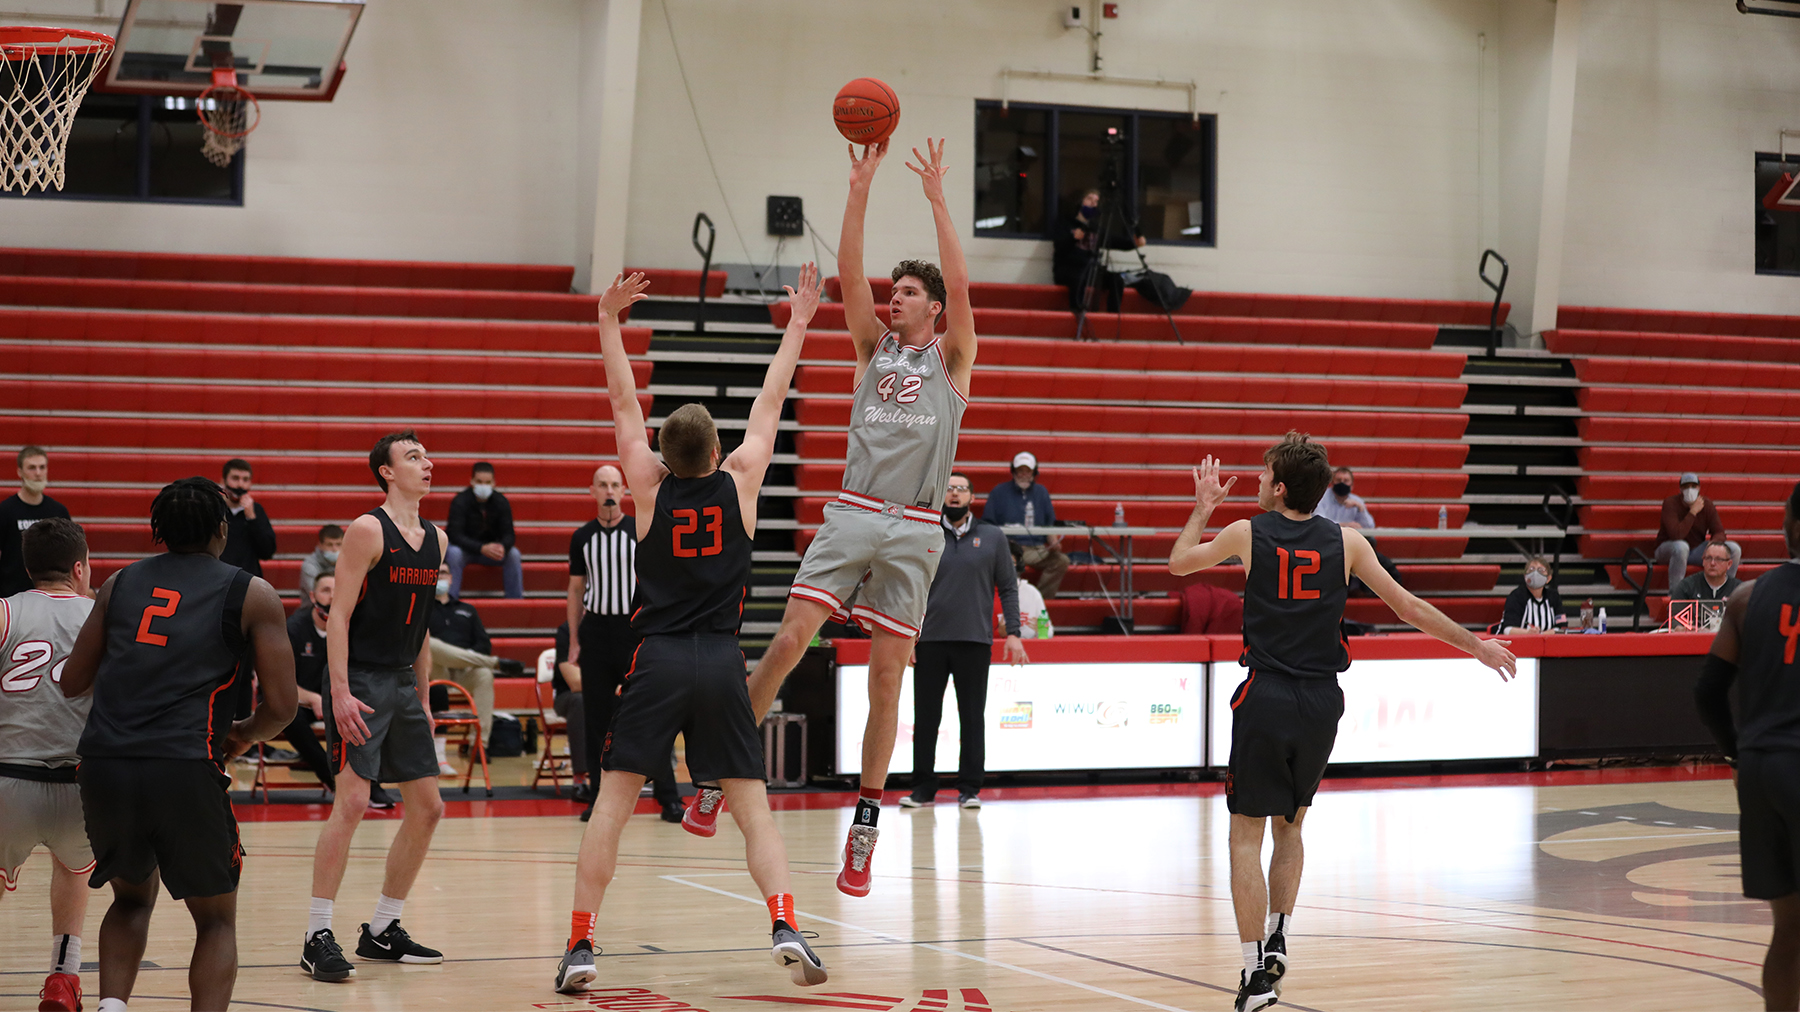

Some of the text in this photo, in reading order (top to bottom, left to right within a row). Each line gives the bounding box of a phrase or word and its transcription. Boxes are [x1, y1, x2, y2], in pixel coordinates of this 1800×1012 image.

[876, 371, 923, 404] 42
[864, 405, 937, 429] Wesleyan
[671, 505, 723, 558] 23
[389, 565, 439, 586] WARRIORS
[1276, 546, 1321, 600] 12
[135, 586, 182, 647] 2
[405, 592, 417, 625] 1
[1, 640, 69, 692] 2
[1054, 703, 1095, 714] WIWU
[1150, 704, 1171, 714] 860
